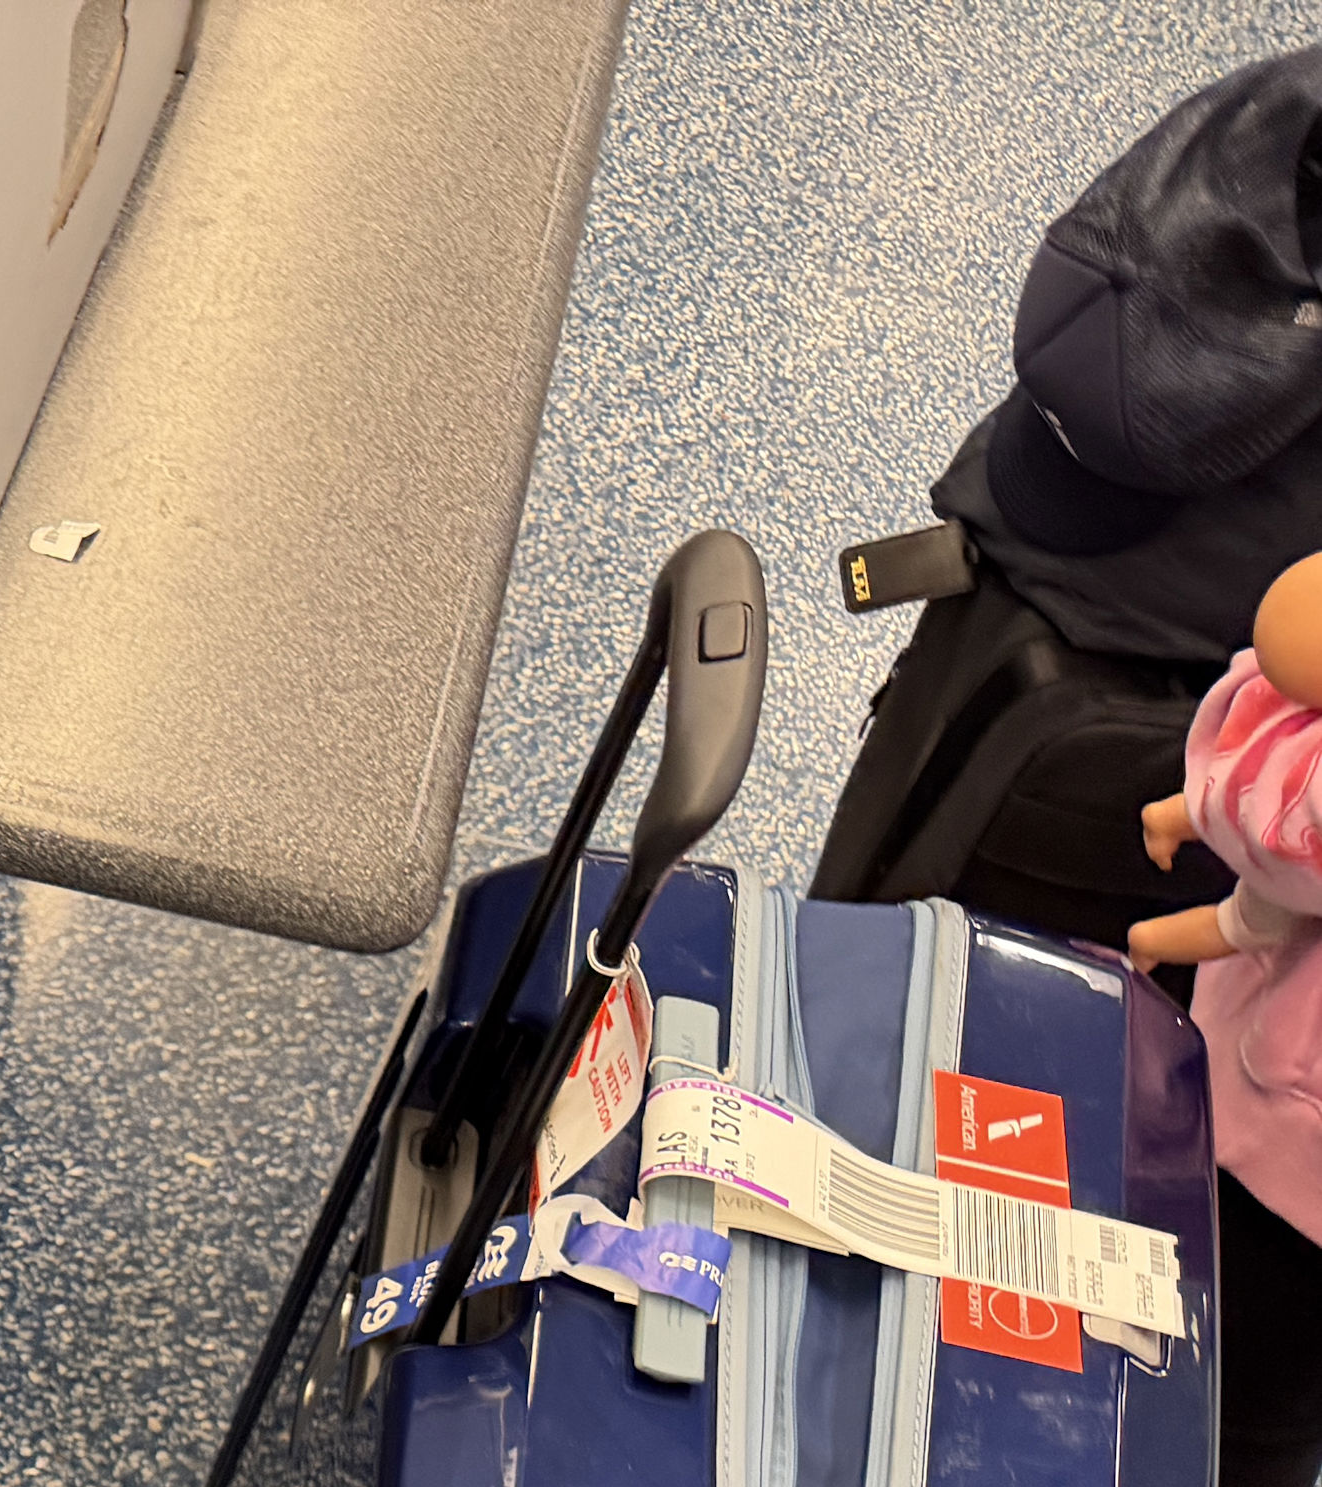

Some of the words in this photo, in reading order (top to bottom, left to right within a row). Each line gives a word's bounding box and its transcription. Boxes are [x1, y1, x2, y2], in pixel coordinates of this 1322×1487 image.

[604, 1060, 624, 1108] WITH
[617, 1051, 633, 1087] LIFT
[588, 1065, 614, 1134] CAUTION
[709, 1095, 742, 1147] 1378
[959, 1082, 978, 1152] American
[657, 1129, 688, 1166] LAS
[360, 1275, 405, 1335] 49
